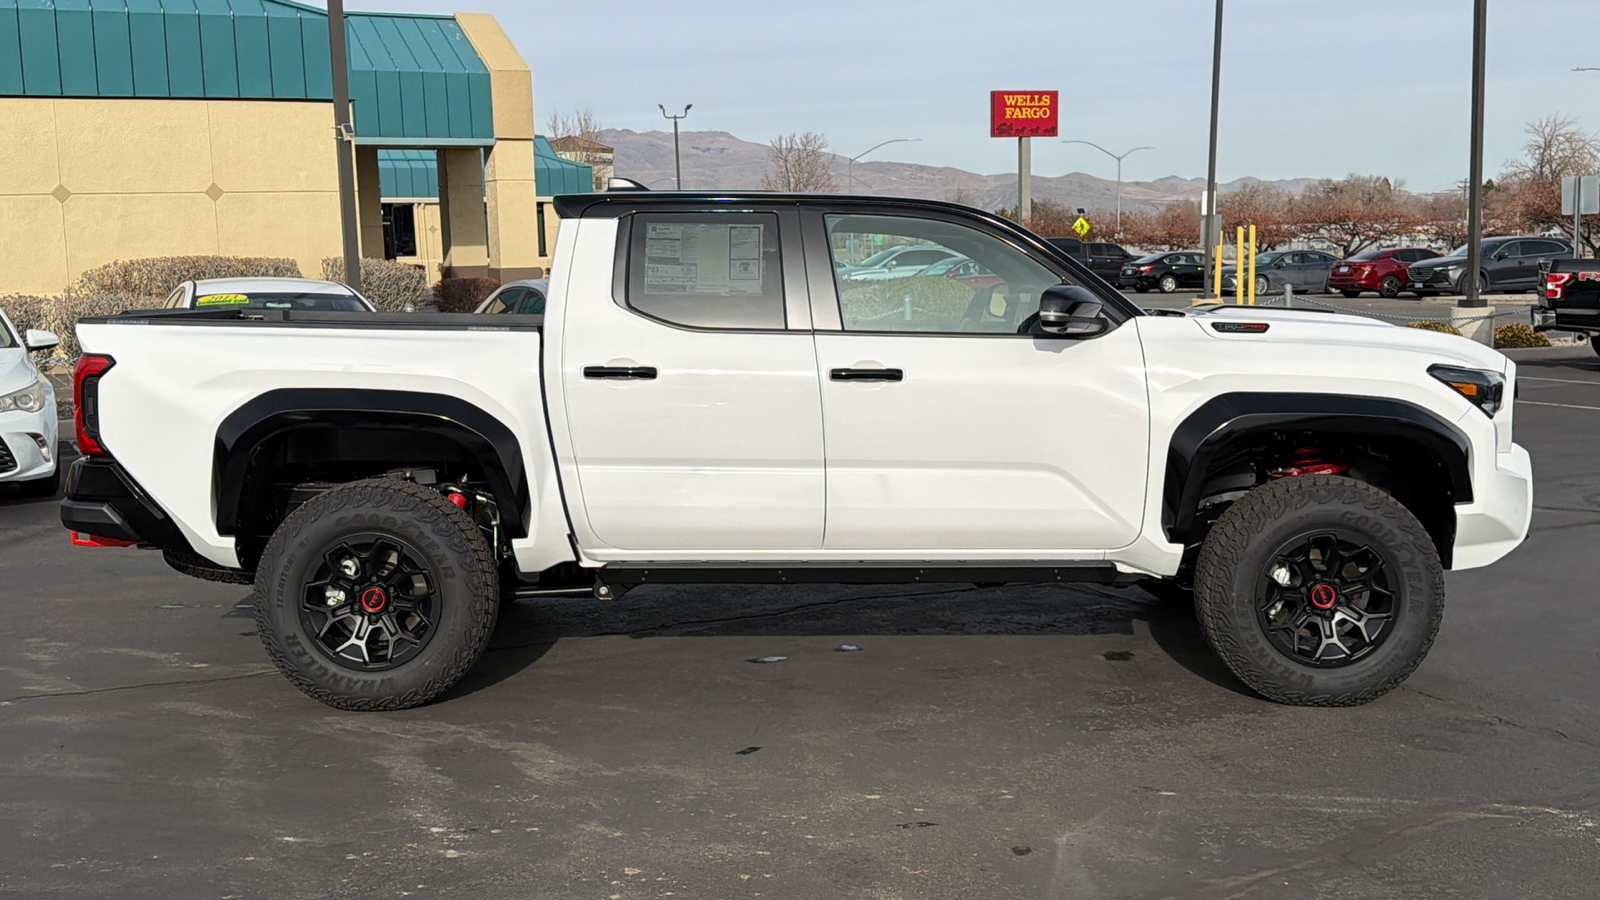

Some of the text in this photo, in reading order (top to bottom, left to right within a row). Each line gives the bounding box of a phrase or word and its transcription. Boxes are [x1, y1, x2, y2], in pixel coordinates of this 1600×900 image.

[1003, 94, 1051, 106] WELLS
[1004, 107, 1051, 119] FARGO
[335, 512, 457, 581] GOODYEAR
[1342, 510, 1425, 615] GOODYEAR
[276, 553, 298, 609] TERRITORY
[284, 632, 396, 694] WRANGLER
[1234, 590, 1314, 688] WRANGLER
